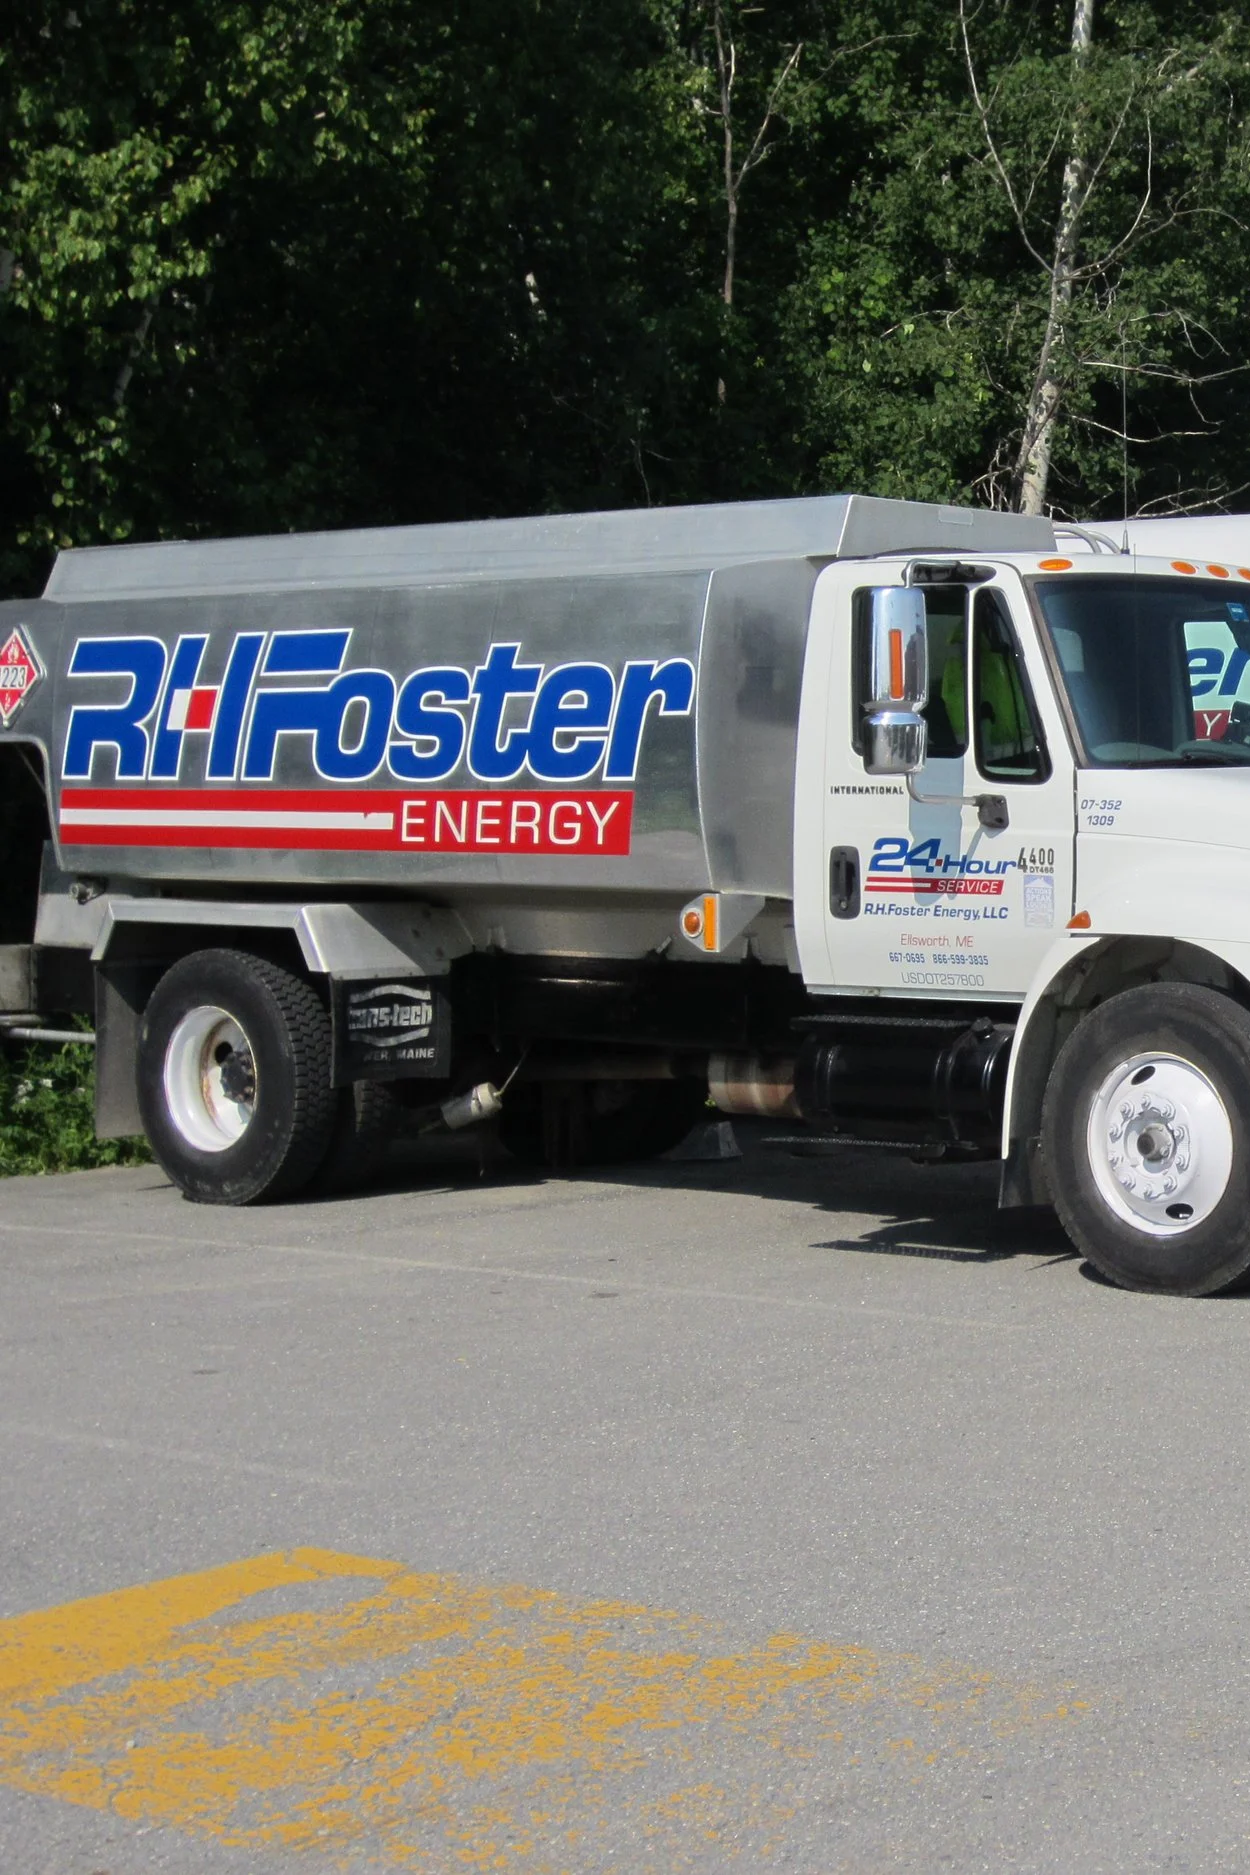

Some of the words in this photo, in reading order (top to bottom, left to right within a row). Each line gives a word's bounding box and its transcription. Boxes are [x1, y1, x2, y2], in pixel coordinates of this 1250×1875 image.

[0, 667, 25, 687] 223
[830, 785, 904, 795] INTERNATIONAL
[1081, 799, 1122, 810] 07-352
[401, 800, 620, 845] ENERGY
[1087, 815, 1115, 826] 1309
[1017, 847, 1055, 873] 4400
[937, 880, 999, 894] SERVICE
[933, 905, 981, 921] Energy,
[983, 907, 1009, 919] LLC
[900, 933, 951, 948] Ellsworth,
[955, 935, 974, 947] ME
[889, 952, 925, 963] 667-0695
[932, 954, 989, 966] 866-599-3835
[397, 1048, 436, 1060] MAINE
